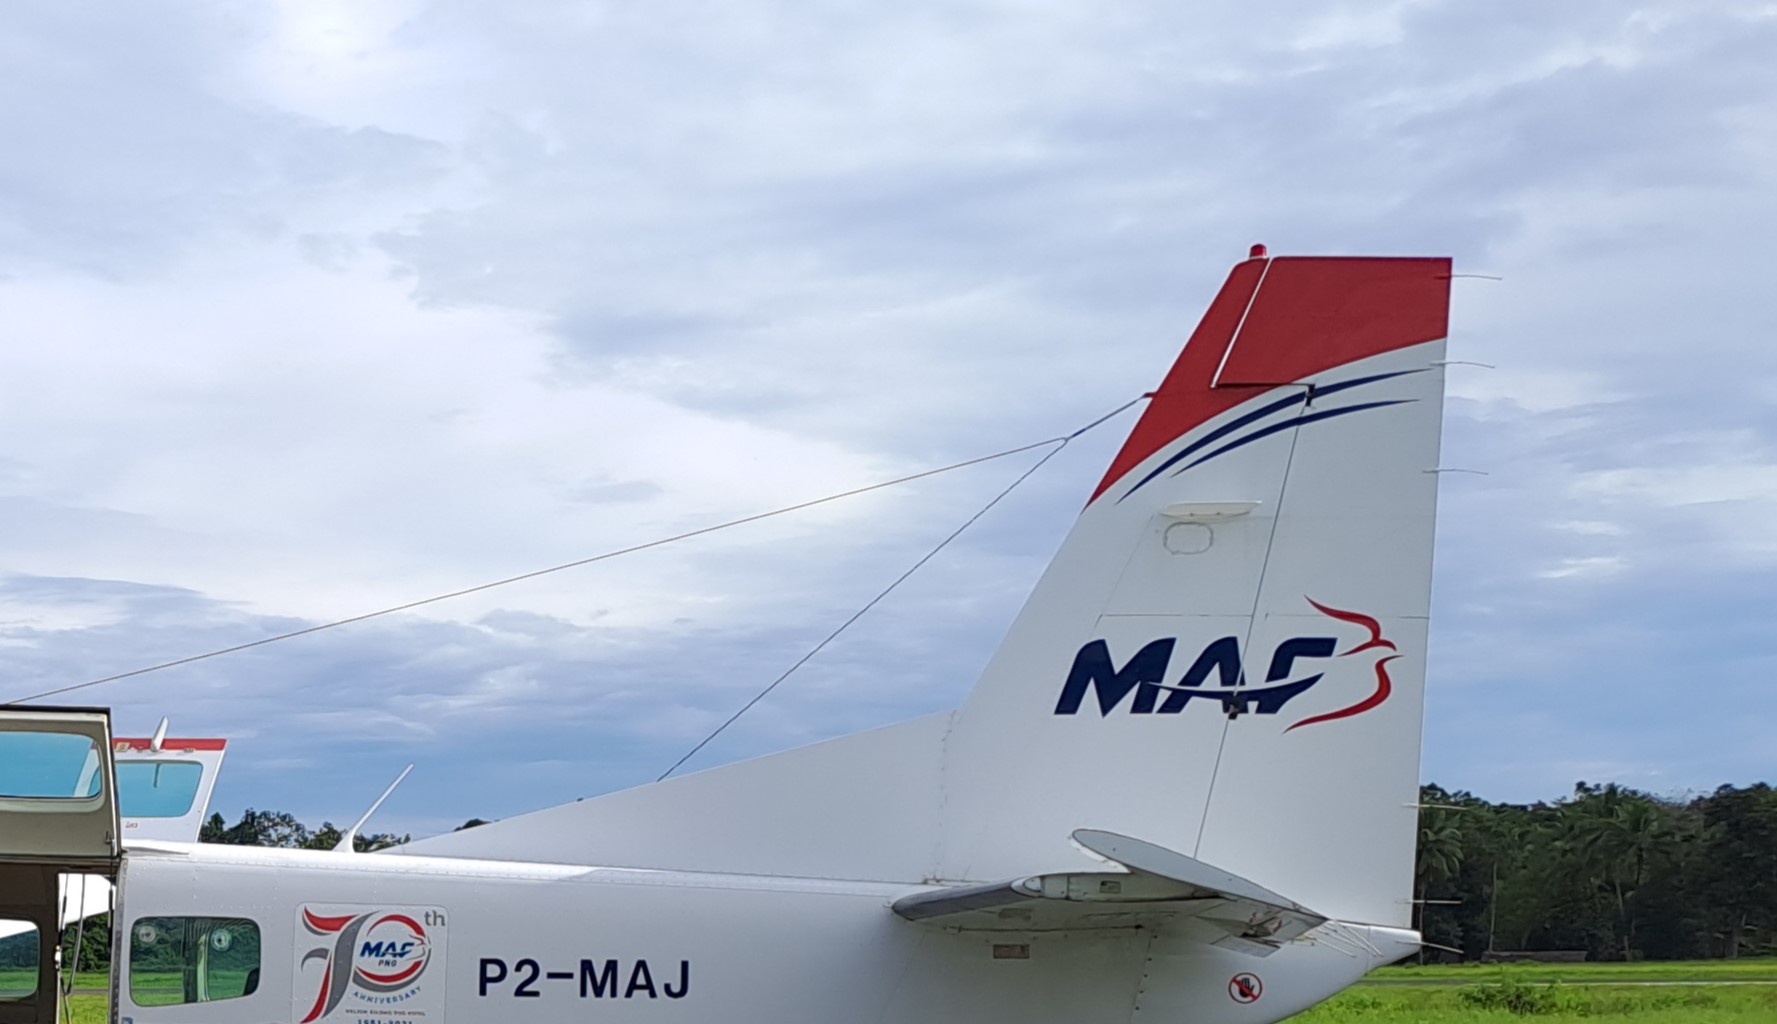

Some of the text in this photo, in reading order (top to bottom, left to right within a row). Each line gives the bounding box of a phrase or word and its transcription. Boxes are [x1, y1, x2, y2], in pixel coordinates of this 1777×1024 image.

[1053, 635, 1338, 718] MAF
[359, 941, 415, 958] MAF
[477, 957, 690, 999] P2-MAJ
[352, 985, 422, 1004] ANNIVERSARY
